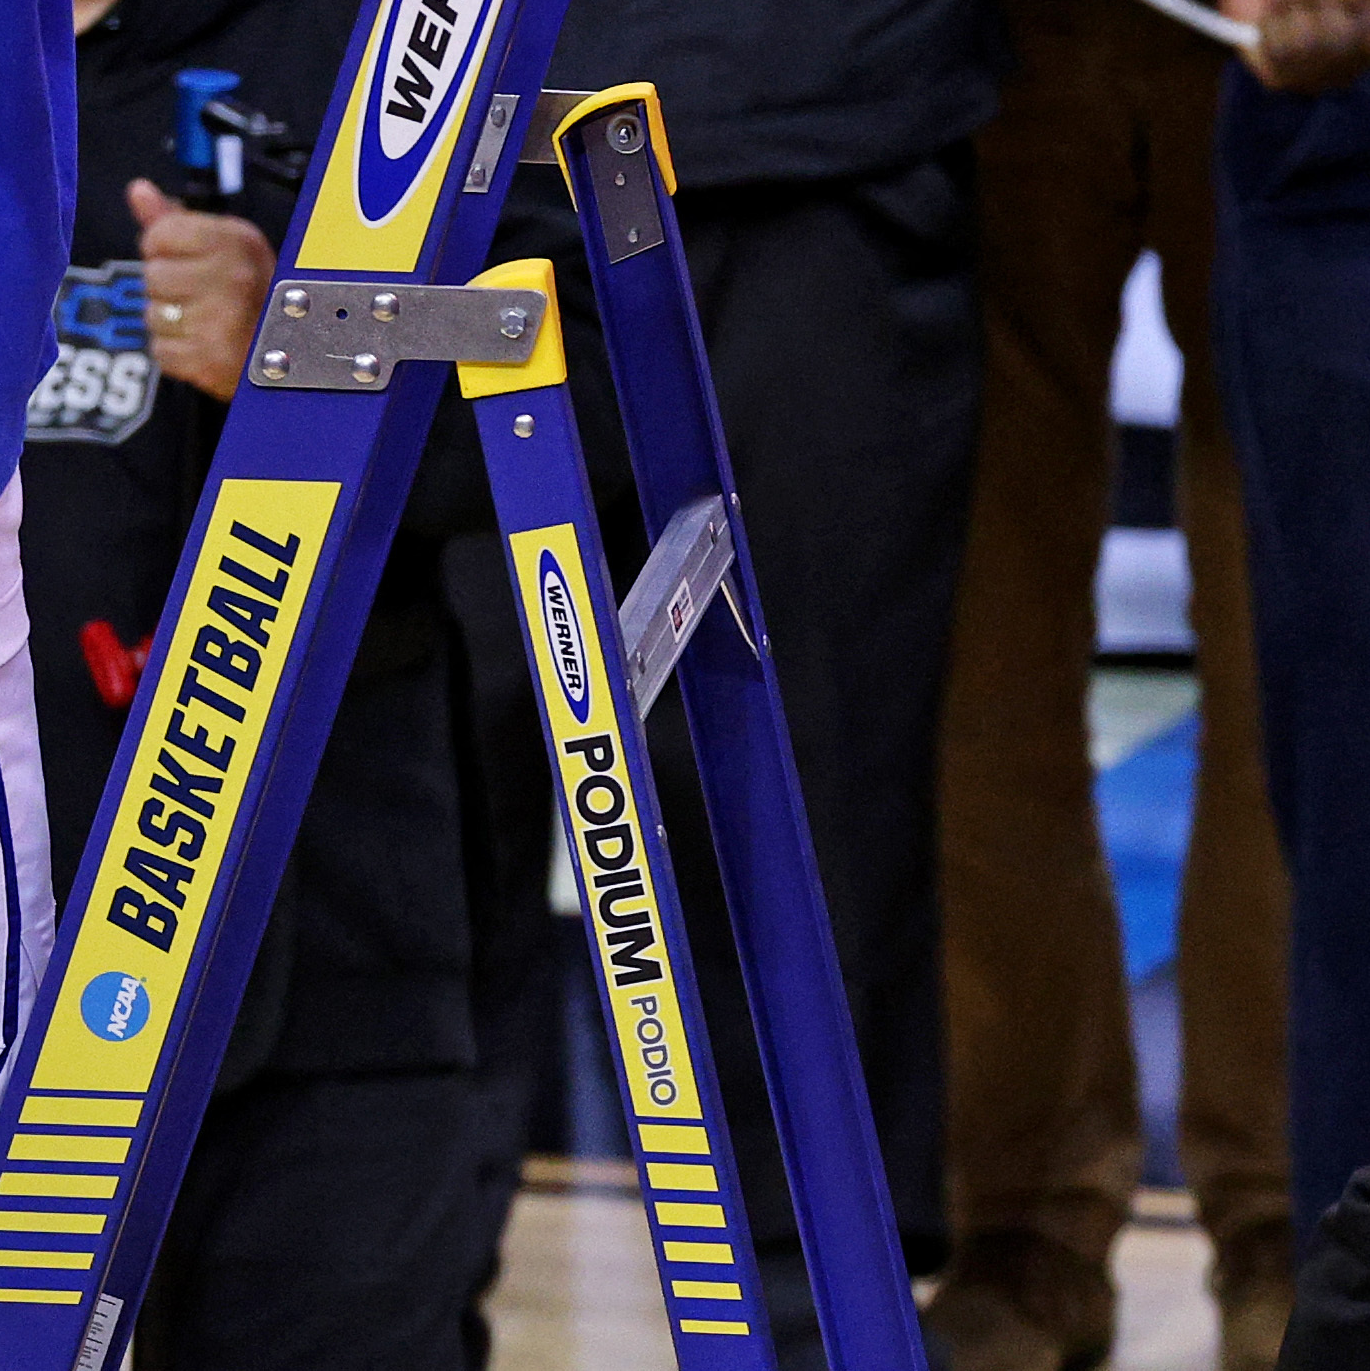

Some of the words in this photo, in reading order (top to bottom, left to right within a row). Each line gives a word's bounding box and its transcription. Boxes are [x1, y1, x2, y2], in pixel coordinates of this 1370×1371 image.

[546, 584, 583, 690] WERNER
[106, 521, 302, 953] BASKETBALL
[564, 733, 663, 990] PODIUM
[107, 977, 140, 1038] NCAA
[630, 995, 677, 1108] PODIO
